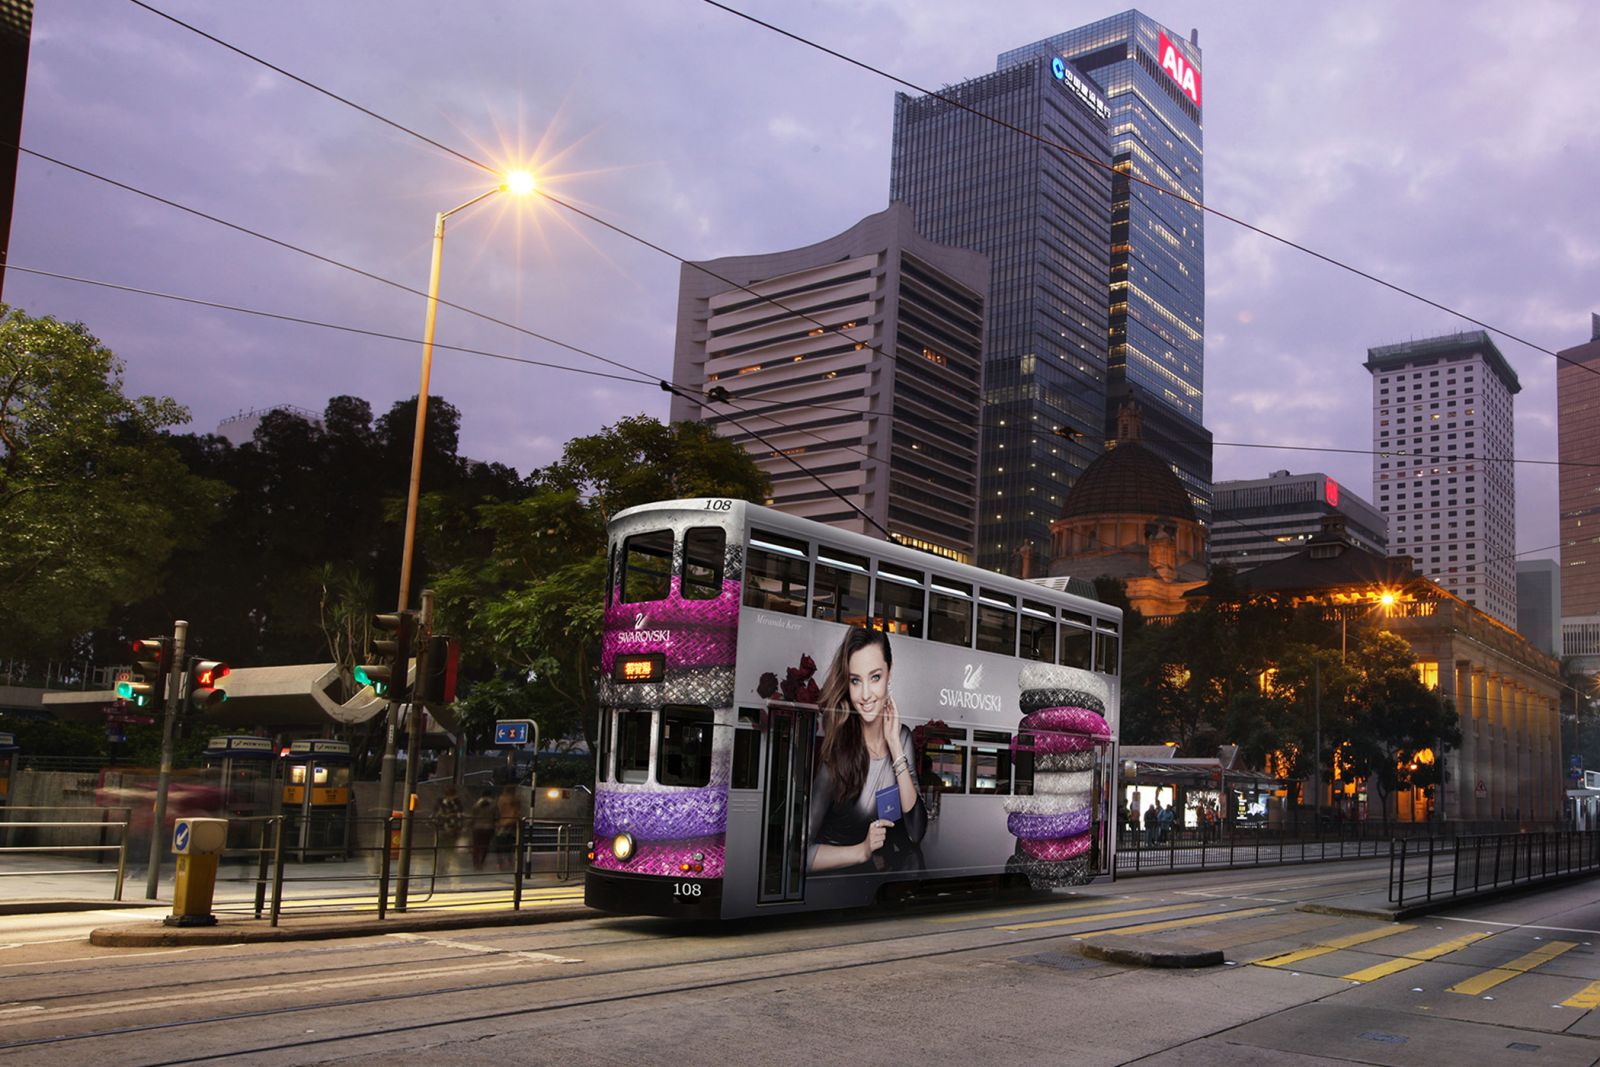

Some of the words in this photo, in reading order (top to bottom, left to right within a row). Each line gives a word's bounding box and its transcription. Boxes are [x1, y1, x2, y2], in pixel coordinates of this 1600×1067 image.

[1162, 45, 1197, 101] AIA
[704, 499, 732, 511] 108
[618, 629, 670, 644] SWAROVSKI
[940, 688, 1002, 712] SWAROVSKI
[673, 882, 702, 897] 108
